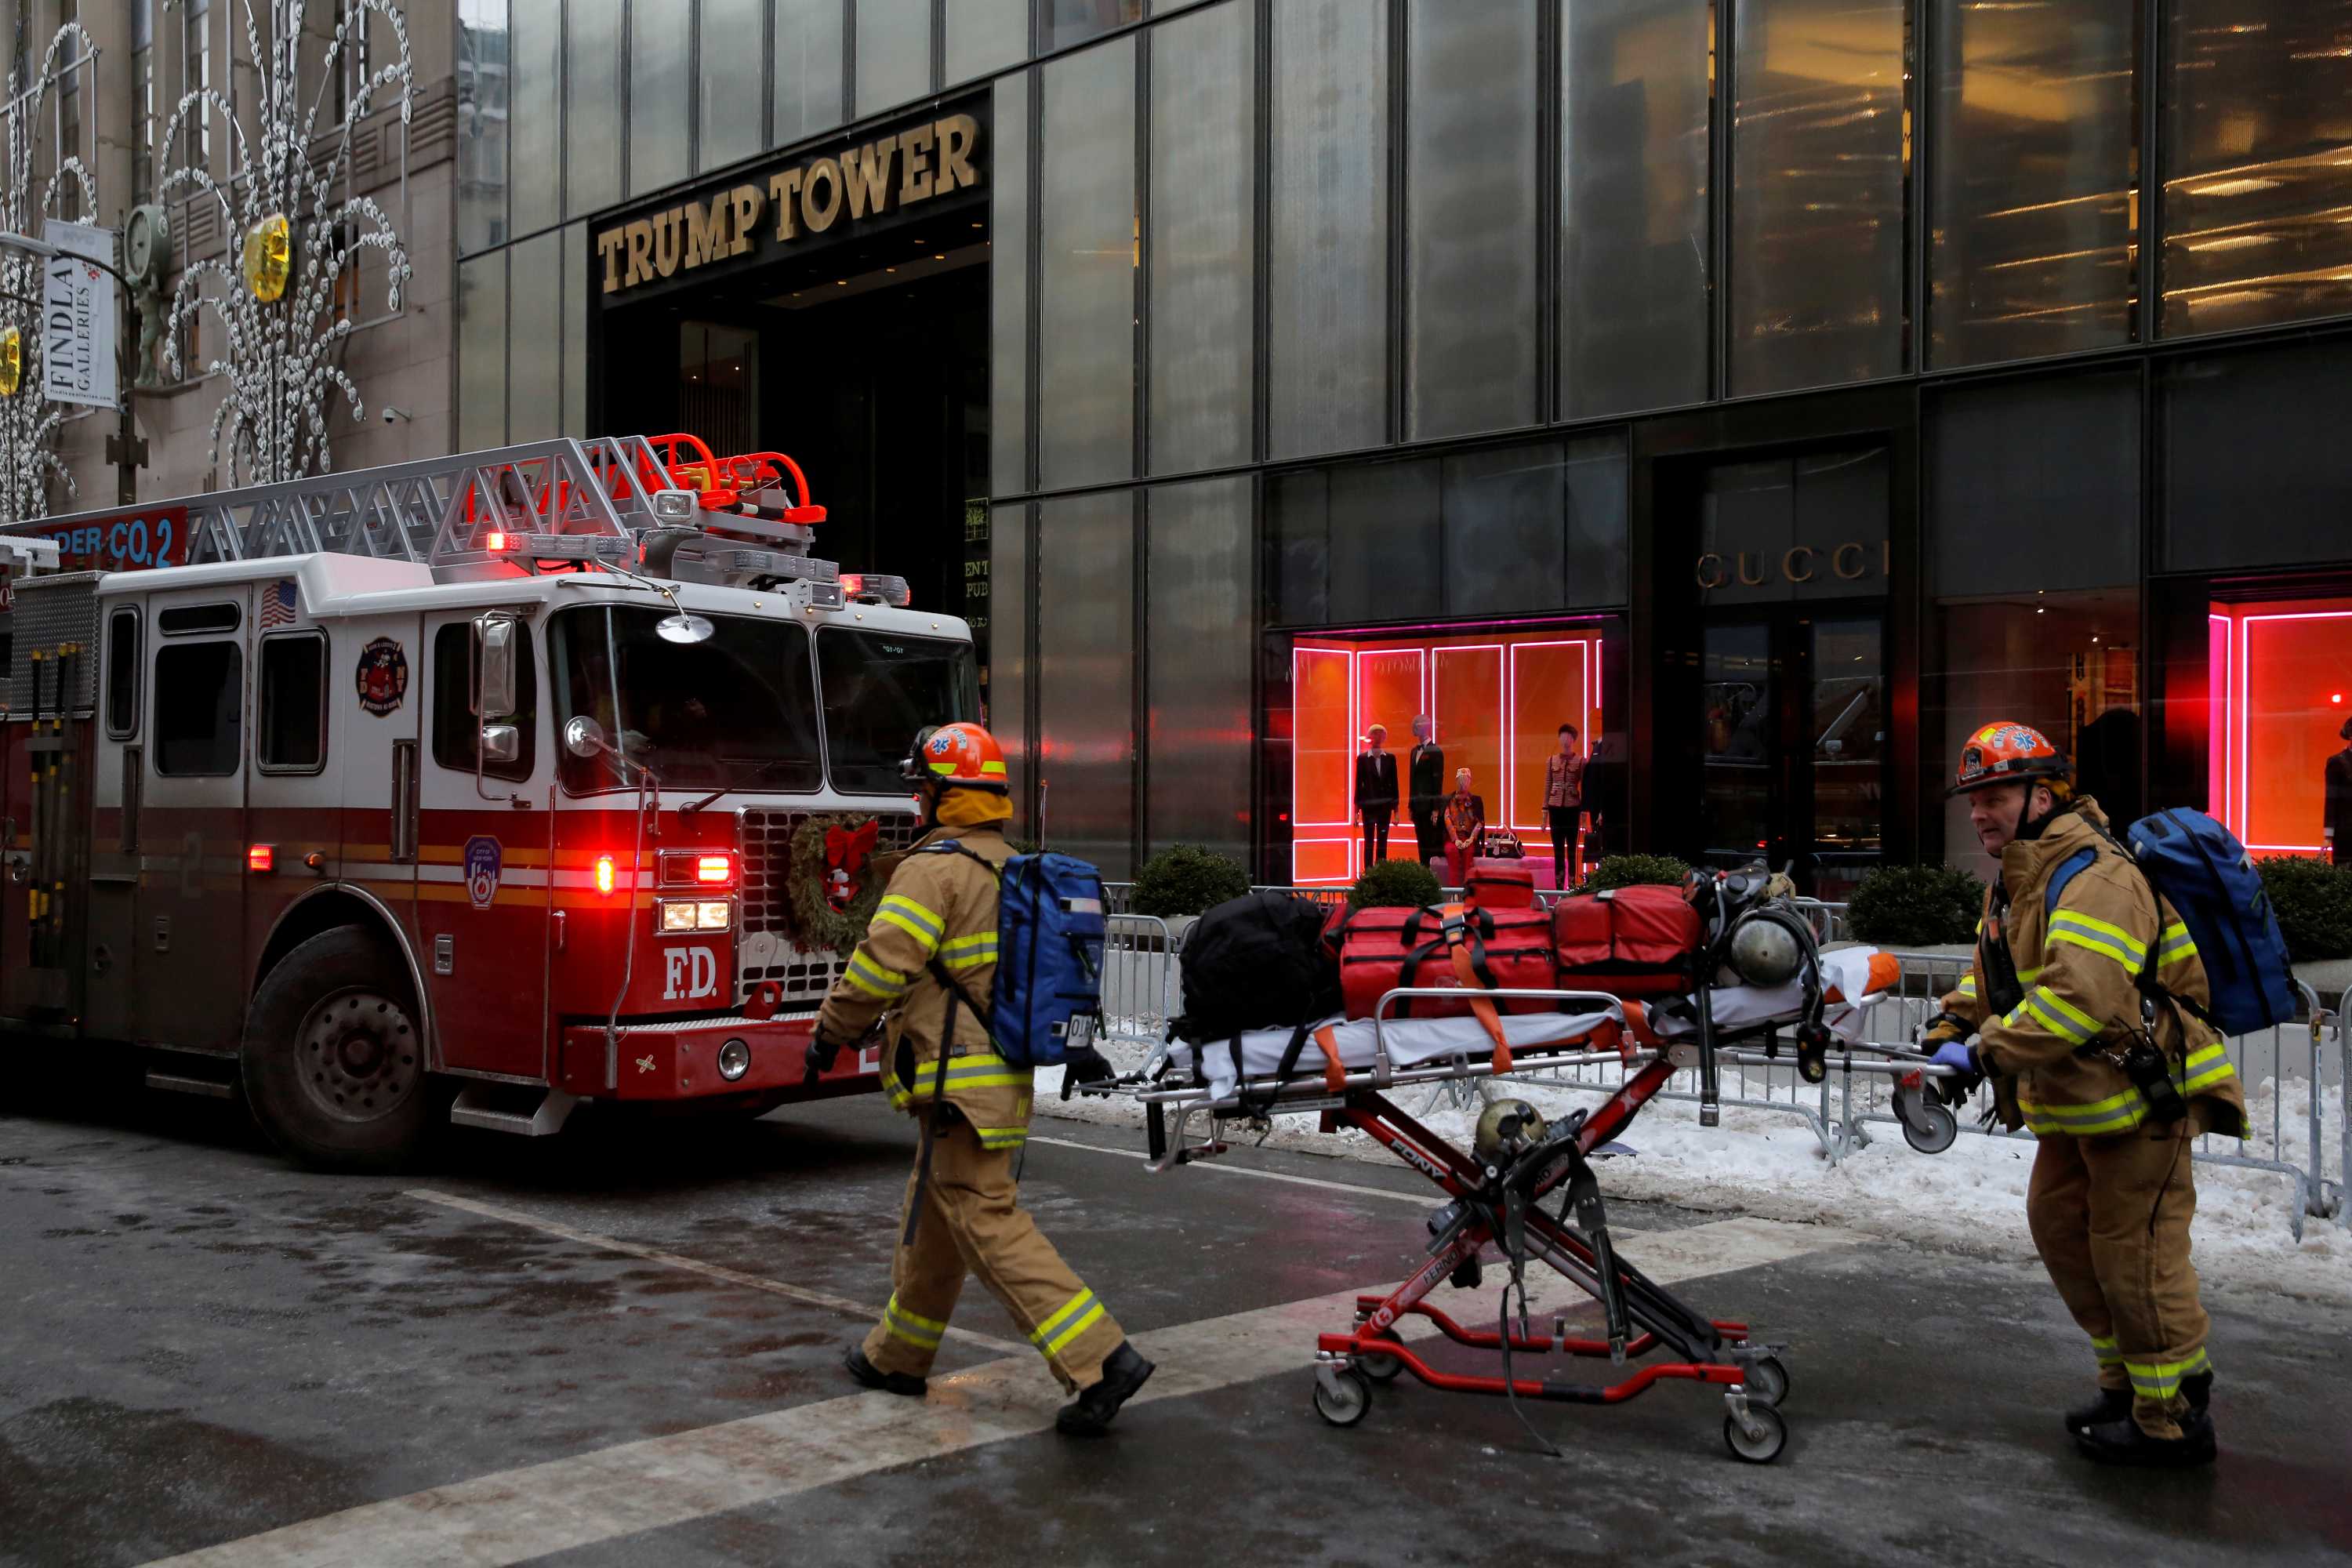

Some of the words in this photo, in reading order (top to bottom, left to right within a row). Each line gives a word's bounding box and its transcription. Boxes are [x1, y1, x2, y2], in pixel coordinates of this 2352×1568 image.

[597, 184, 764, 294] TRUMP
[770, 114, 979, 241] TOWER
[77, 287, 90, 390] GALLERIES
[42, 527, 103, 554] DER
[1697, 539, 1889, 588] GUCCI
[663, 946, 717, 1000] F.D.
